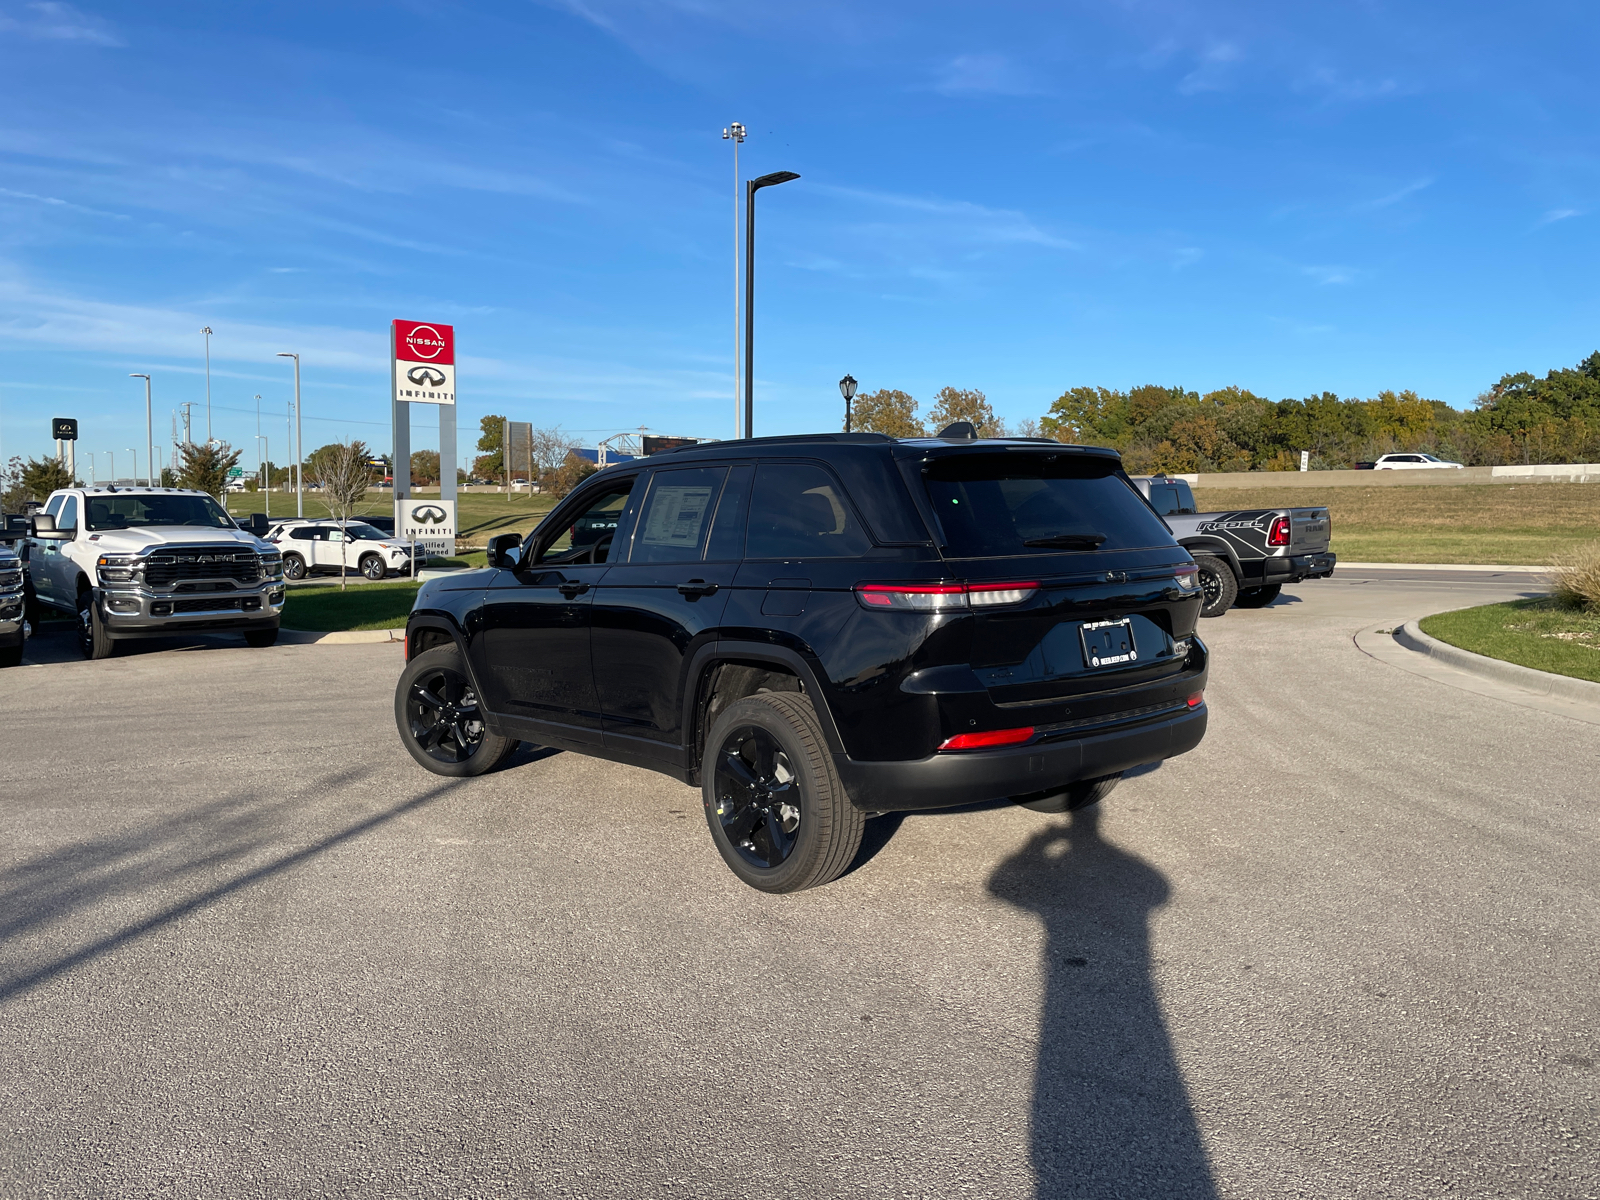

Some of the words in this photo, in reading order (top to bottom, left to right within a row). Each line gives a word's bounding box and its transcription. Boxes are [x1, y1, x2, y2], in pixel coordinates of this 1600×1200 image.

[406, 337, 445, 347] NISSAN
[400, 389, 454, 400] INFINITI
[1195, 520, 1264, 532] REBEL
[1305, 524, 1324, 533] RAM
[425, 541, 445, 549] tified
[177, 554, 233, 563] RAM
